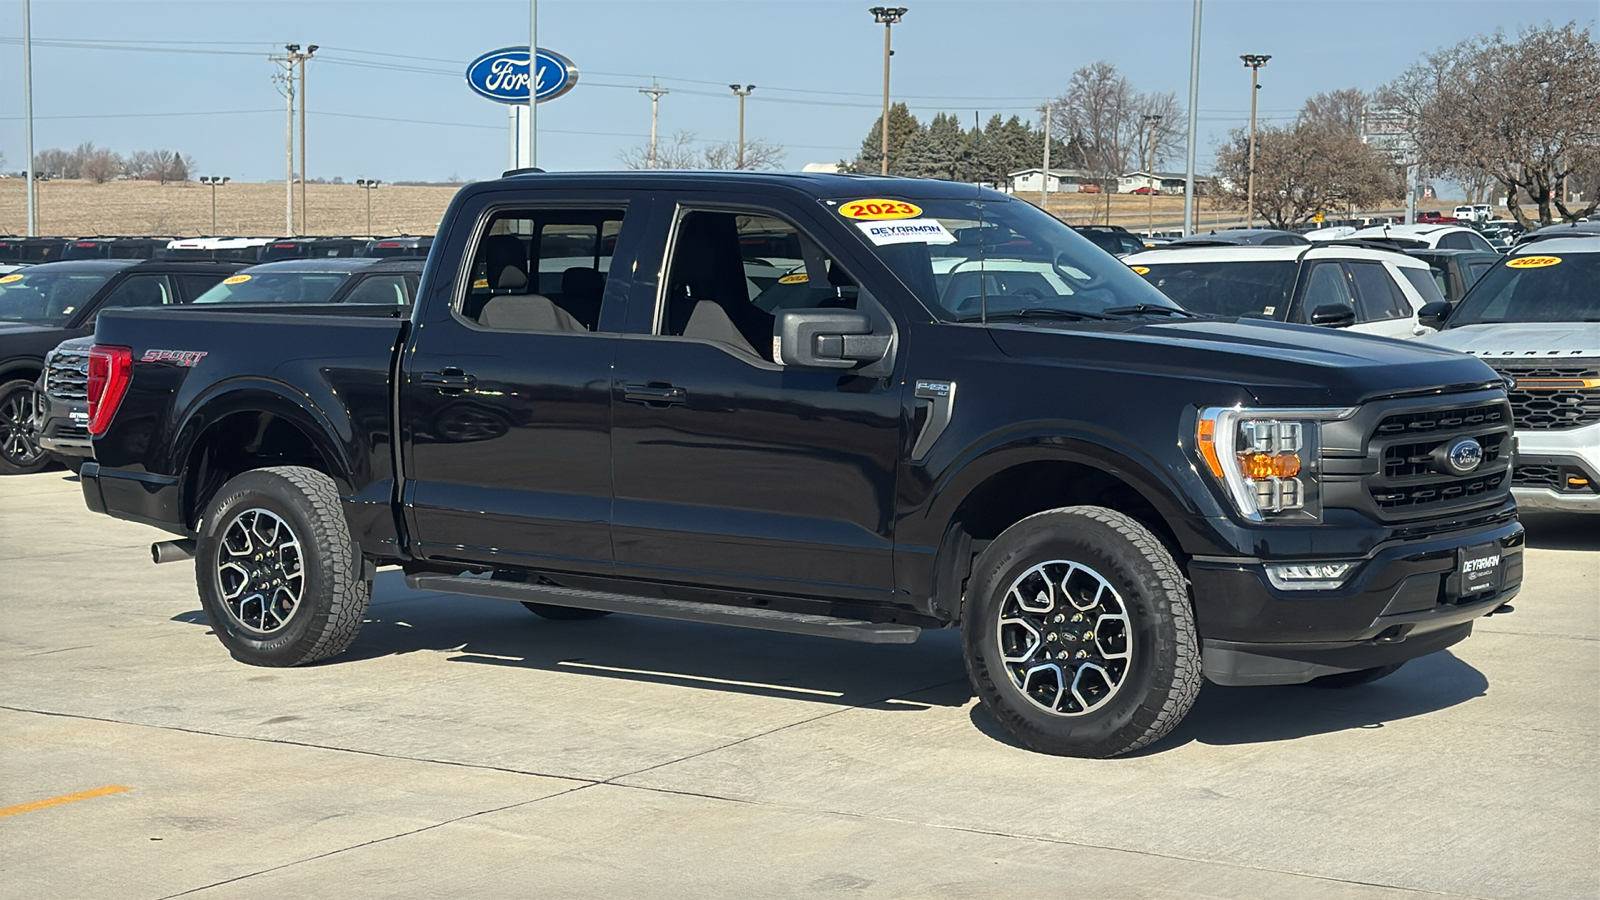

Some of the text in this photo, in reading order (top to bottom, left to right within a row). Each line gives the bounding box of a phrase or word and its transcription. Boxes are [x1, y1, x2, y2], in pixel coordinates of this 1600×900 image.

[485, 57, 547, 91] Ford
[850, 203, 915, 217] 2023
[869, 225, 941, 235] DEYARMAN
[1511, 257, 1557, 266] 2026
[141, 349, 208, 363] SPORT
[1462, 555, 1500, 573] DEYARMAN
